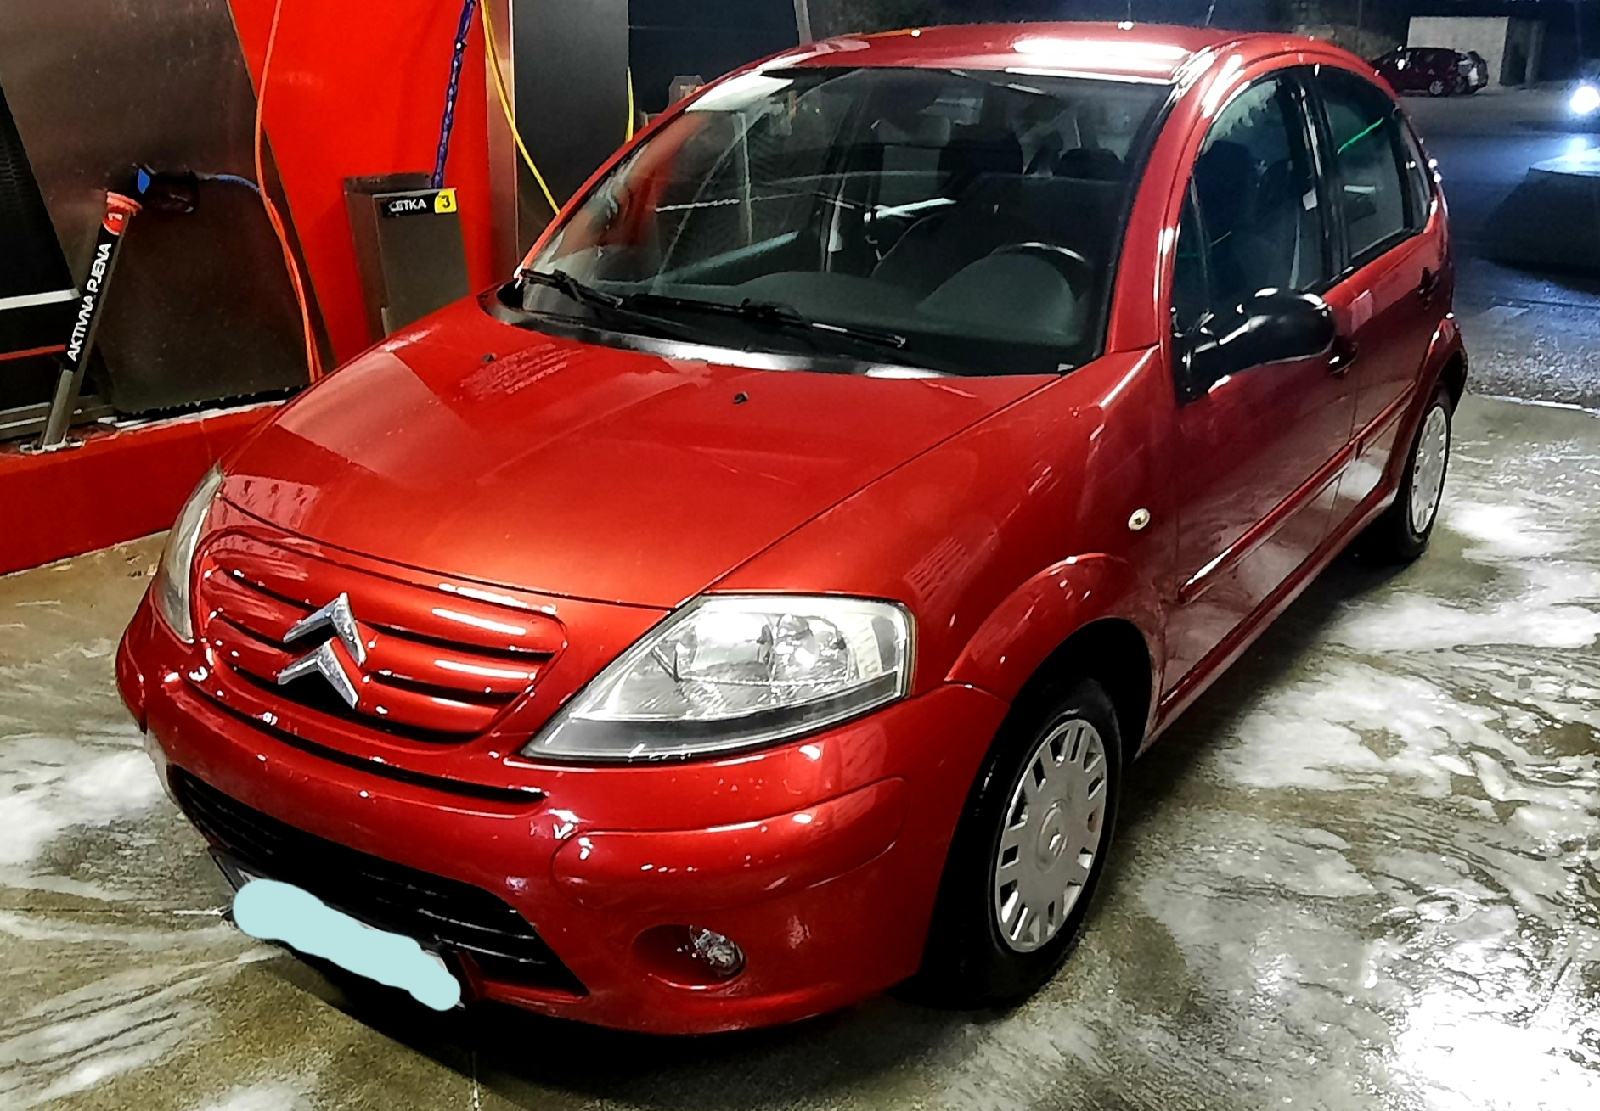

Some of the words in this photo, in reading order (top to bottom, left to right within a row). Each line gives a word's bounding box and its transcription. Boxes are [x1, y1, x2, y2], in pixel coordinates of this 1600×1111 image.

[441, 195, 451, 209] 3
[67, 295, 94, 362] AKTIVNA
[86, 243, 112, 293] PJENA
